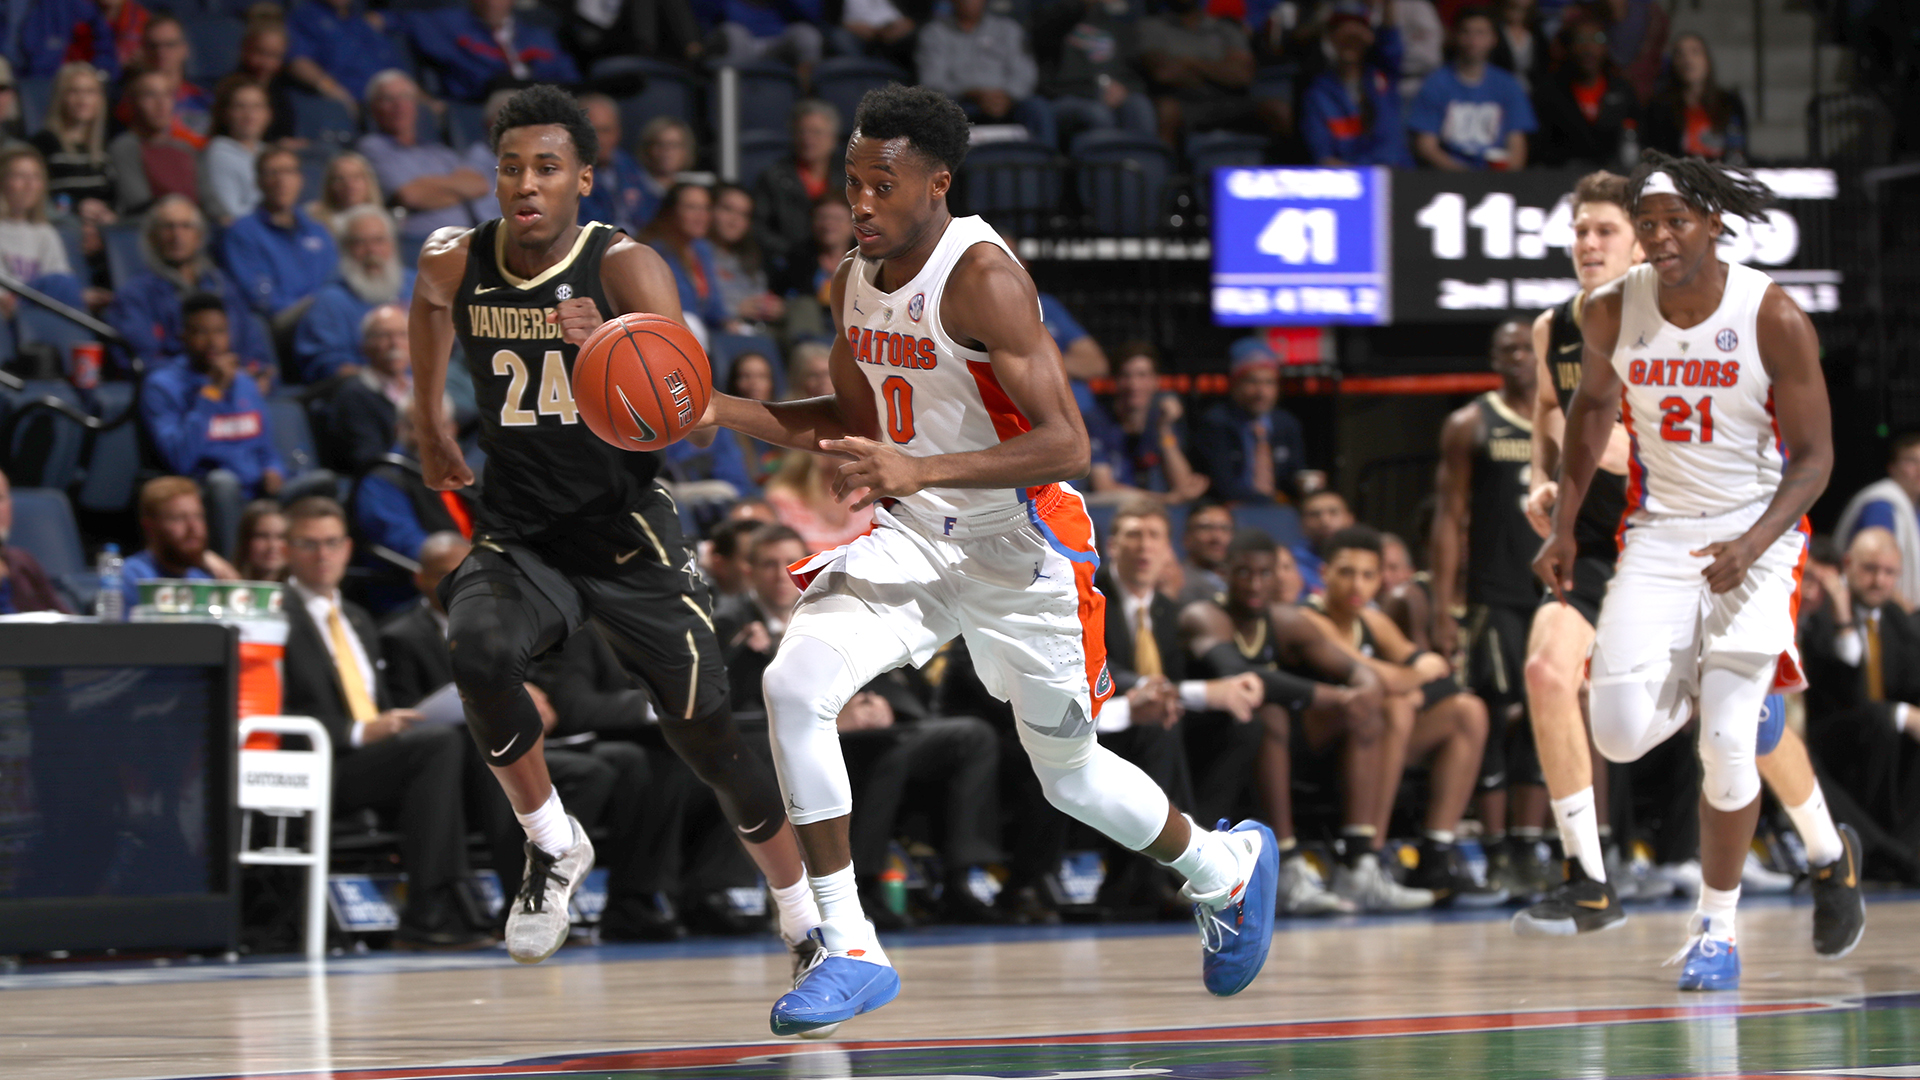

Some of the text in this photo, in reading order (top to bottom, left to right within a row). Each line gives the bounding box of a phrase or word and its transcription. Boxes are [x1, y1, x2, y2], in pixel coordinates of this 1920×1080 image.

[1256, 207, 1338, 265] 41
[848, 325, 938, 370] GATORS
[1628, 358, 1740, 388] GATORS
[492, 349, 579, 426] 24
[663, 370, 694, 429] ELITE
[881, 375, 916, 445] 0
[1659, 395, 1714, 443] 21
[943, 515, 958, 537] F
